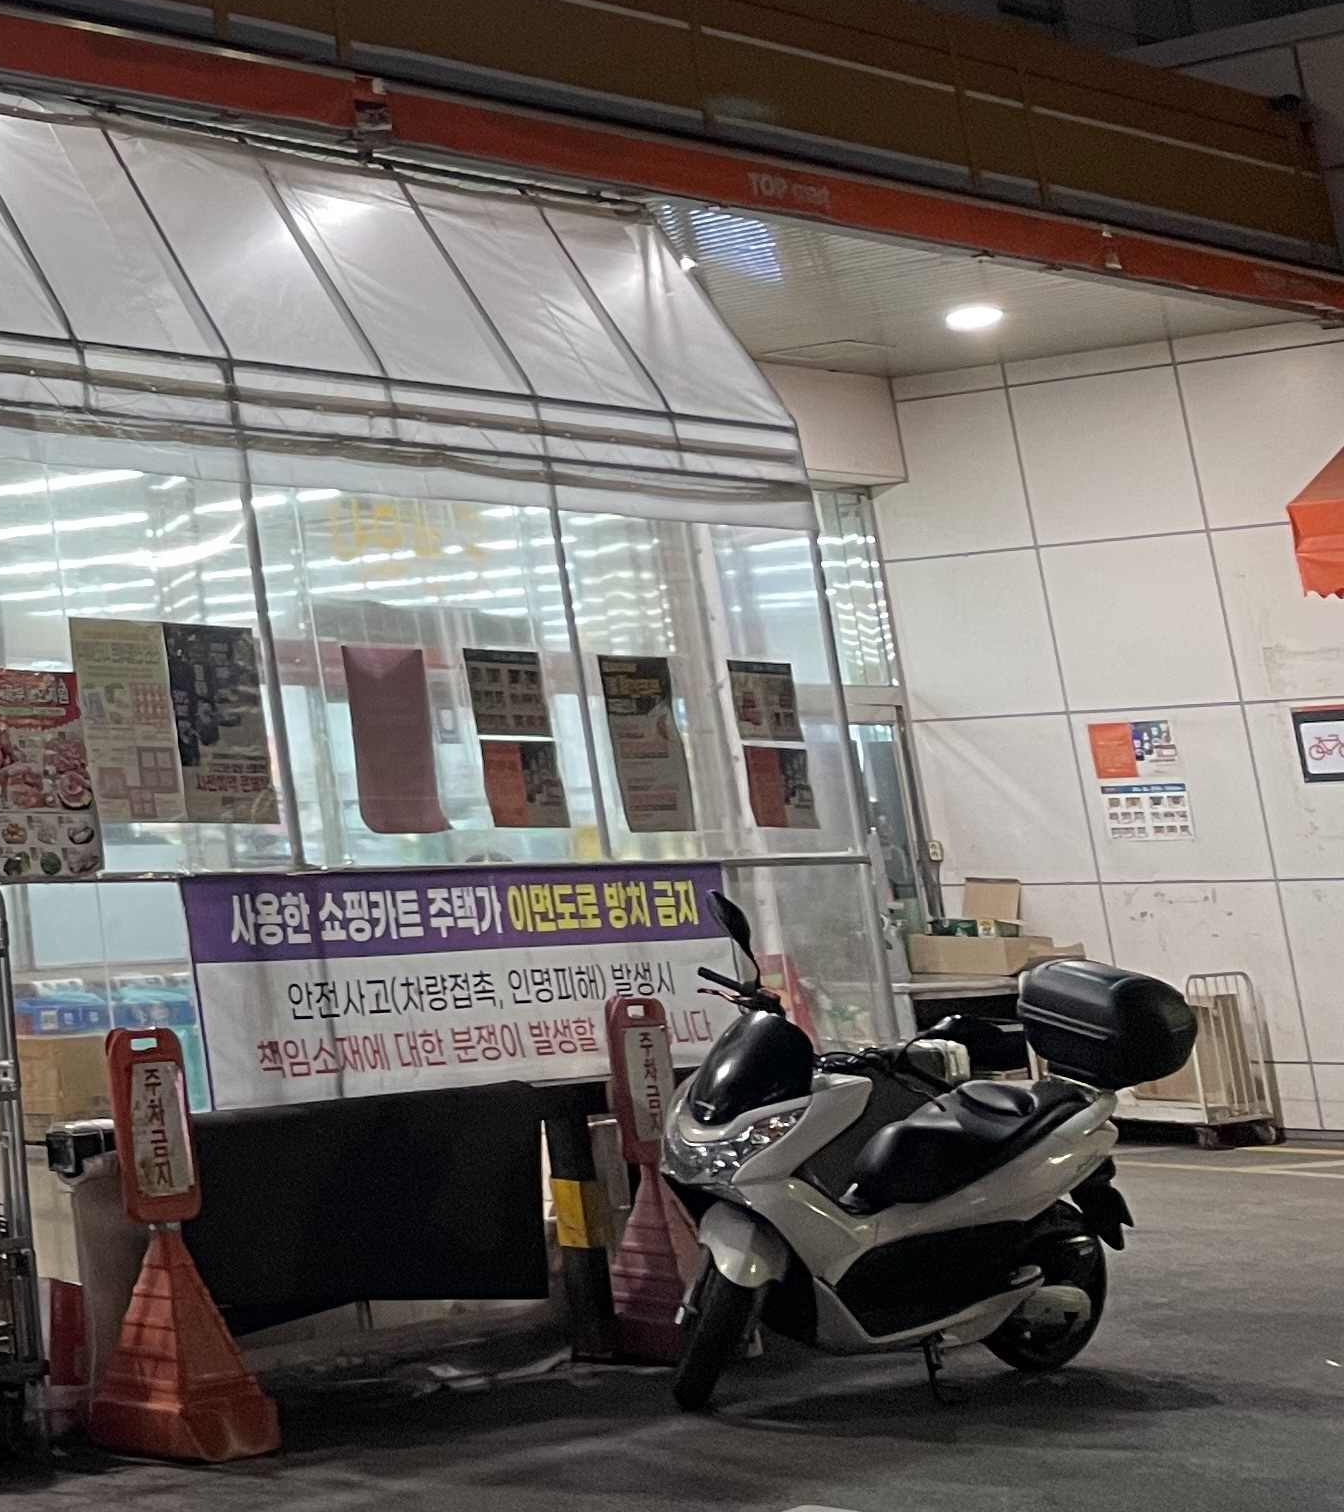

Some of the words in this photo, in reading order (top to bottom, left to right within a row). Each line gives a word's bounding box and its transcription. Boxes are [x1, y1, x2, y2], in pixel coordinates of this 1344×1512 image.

[231, 891, 312, 945] 사용한
[319, 890, 424, 942] 쇼핑카트
[427, 885, 503, 938] 주택가
[507, 883, 602, 932] 이면도로
[604, 881, 651, 928] 방치
[653, 880, 699, 927] 금지
[508, 964, 607, 1004] 인명피해)
[611, 961, 676, 997] 발생시
[257, 1033, 391, 1078] 책임소재에
[393, 1029, 447, 1068] 대한
[450, 1021, 526, 1064] 분쟁이
[528, 1016, 599, 1057] 발생할
[144, 1068, 175, 1188] 주차금지
